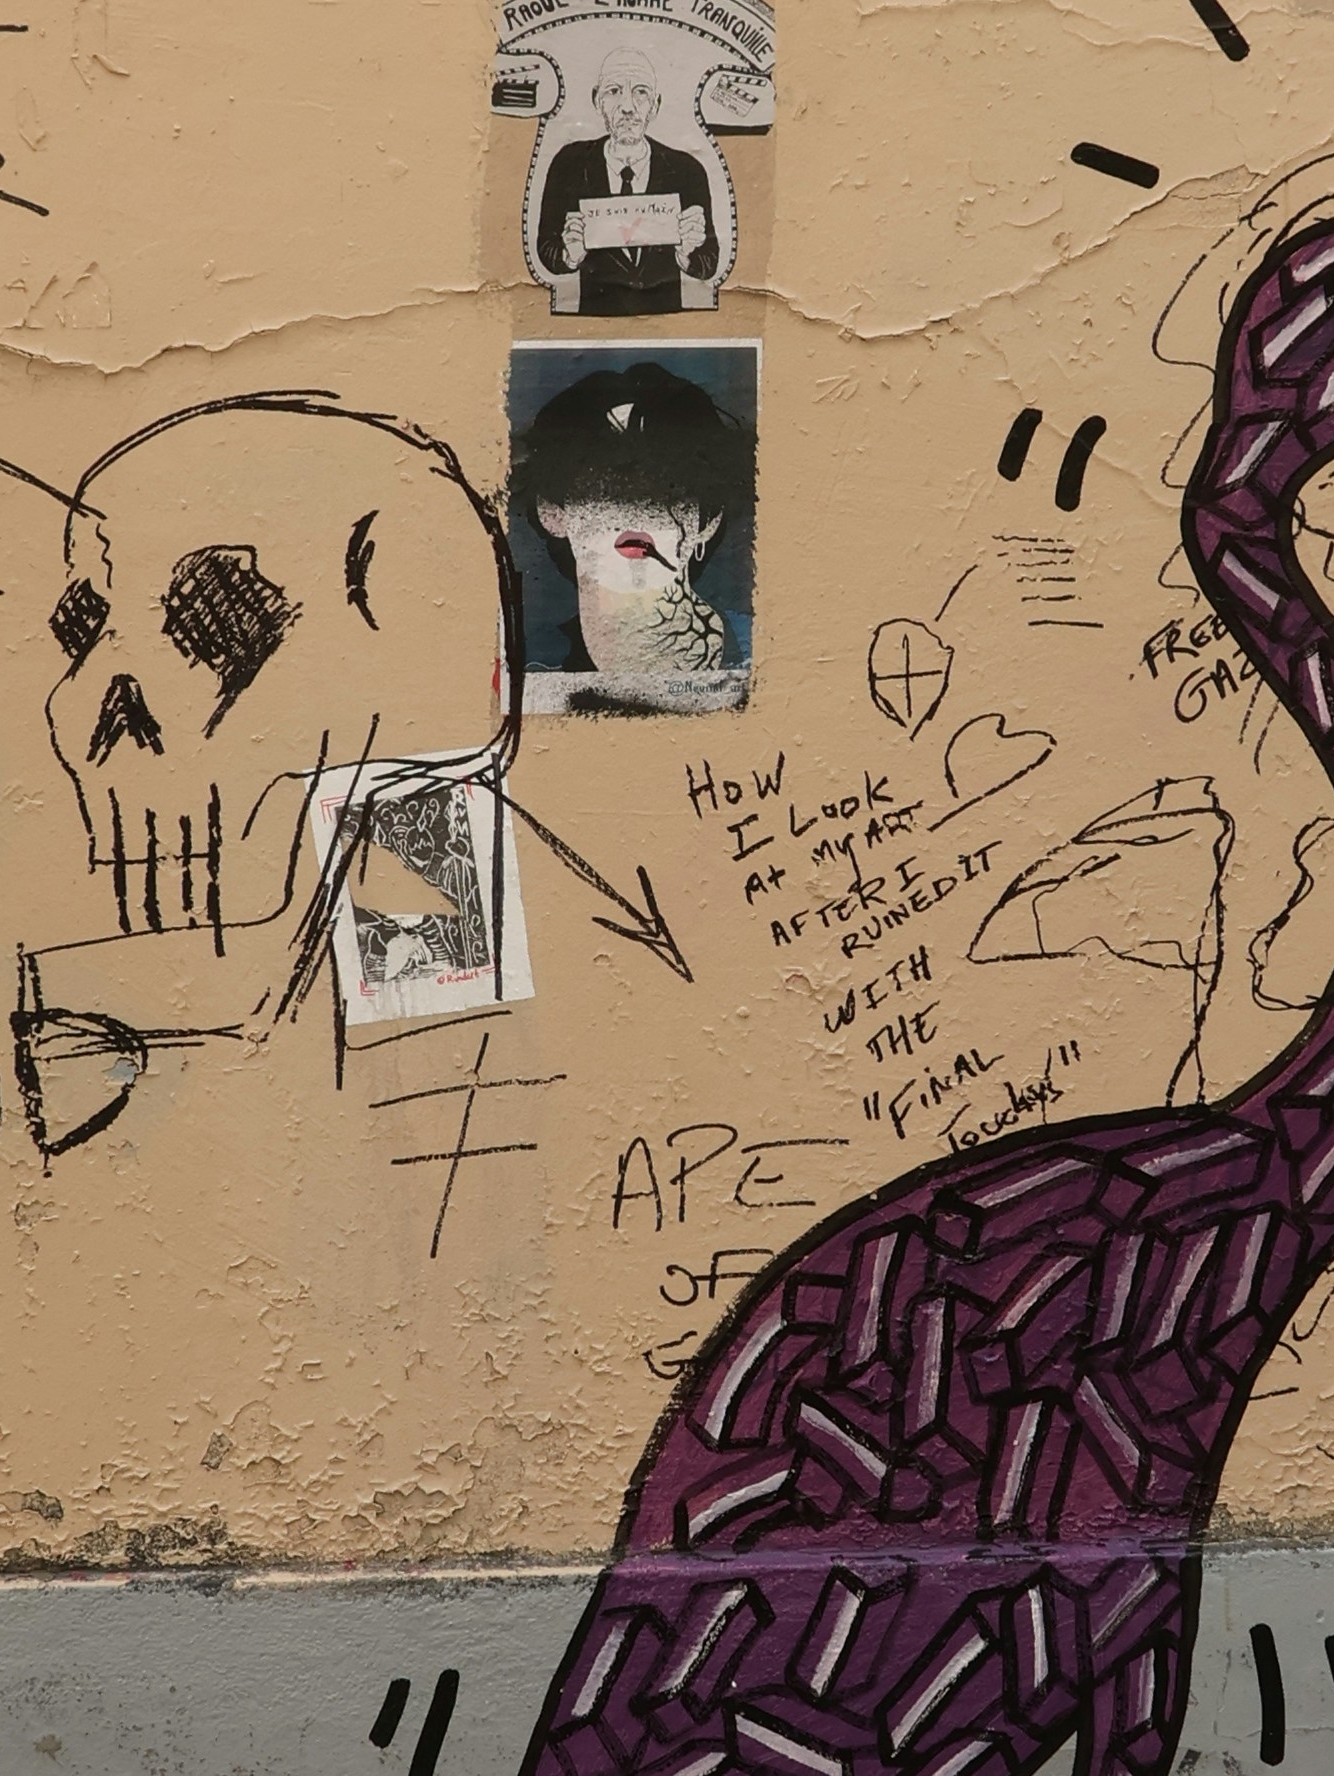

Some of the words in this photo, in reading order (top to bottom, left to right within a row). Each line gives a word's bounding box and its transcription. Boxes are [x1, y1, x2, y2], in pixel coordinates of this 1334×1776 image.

[727, 813, 775, 862] I
[770, 877, 887, 947] AFTER
[824, 945, 932, 1033] WITH
[866, 1000, 941, 1063] THE
[611, 1122, 850, 1232] APE
